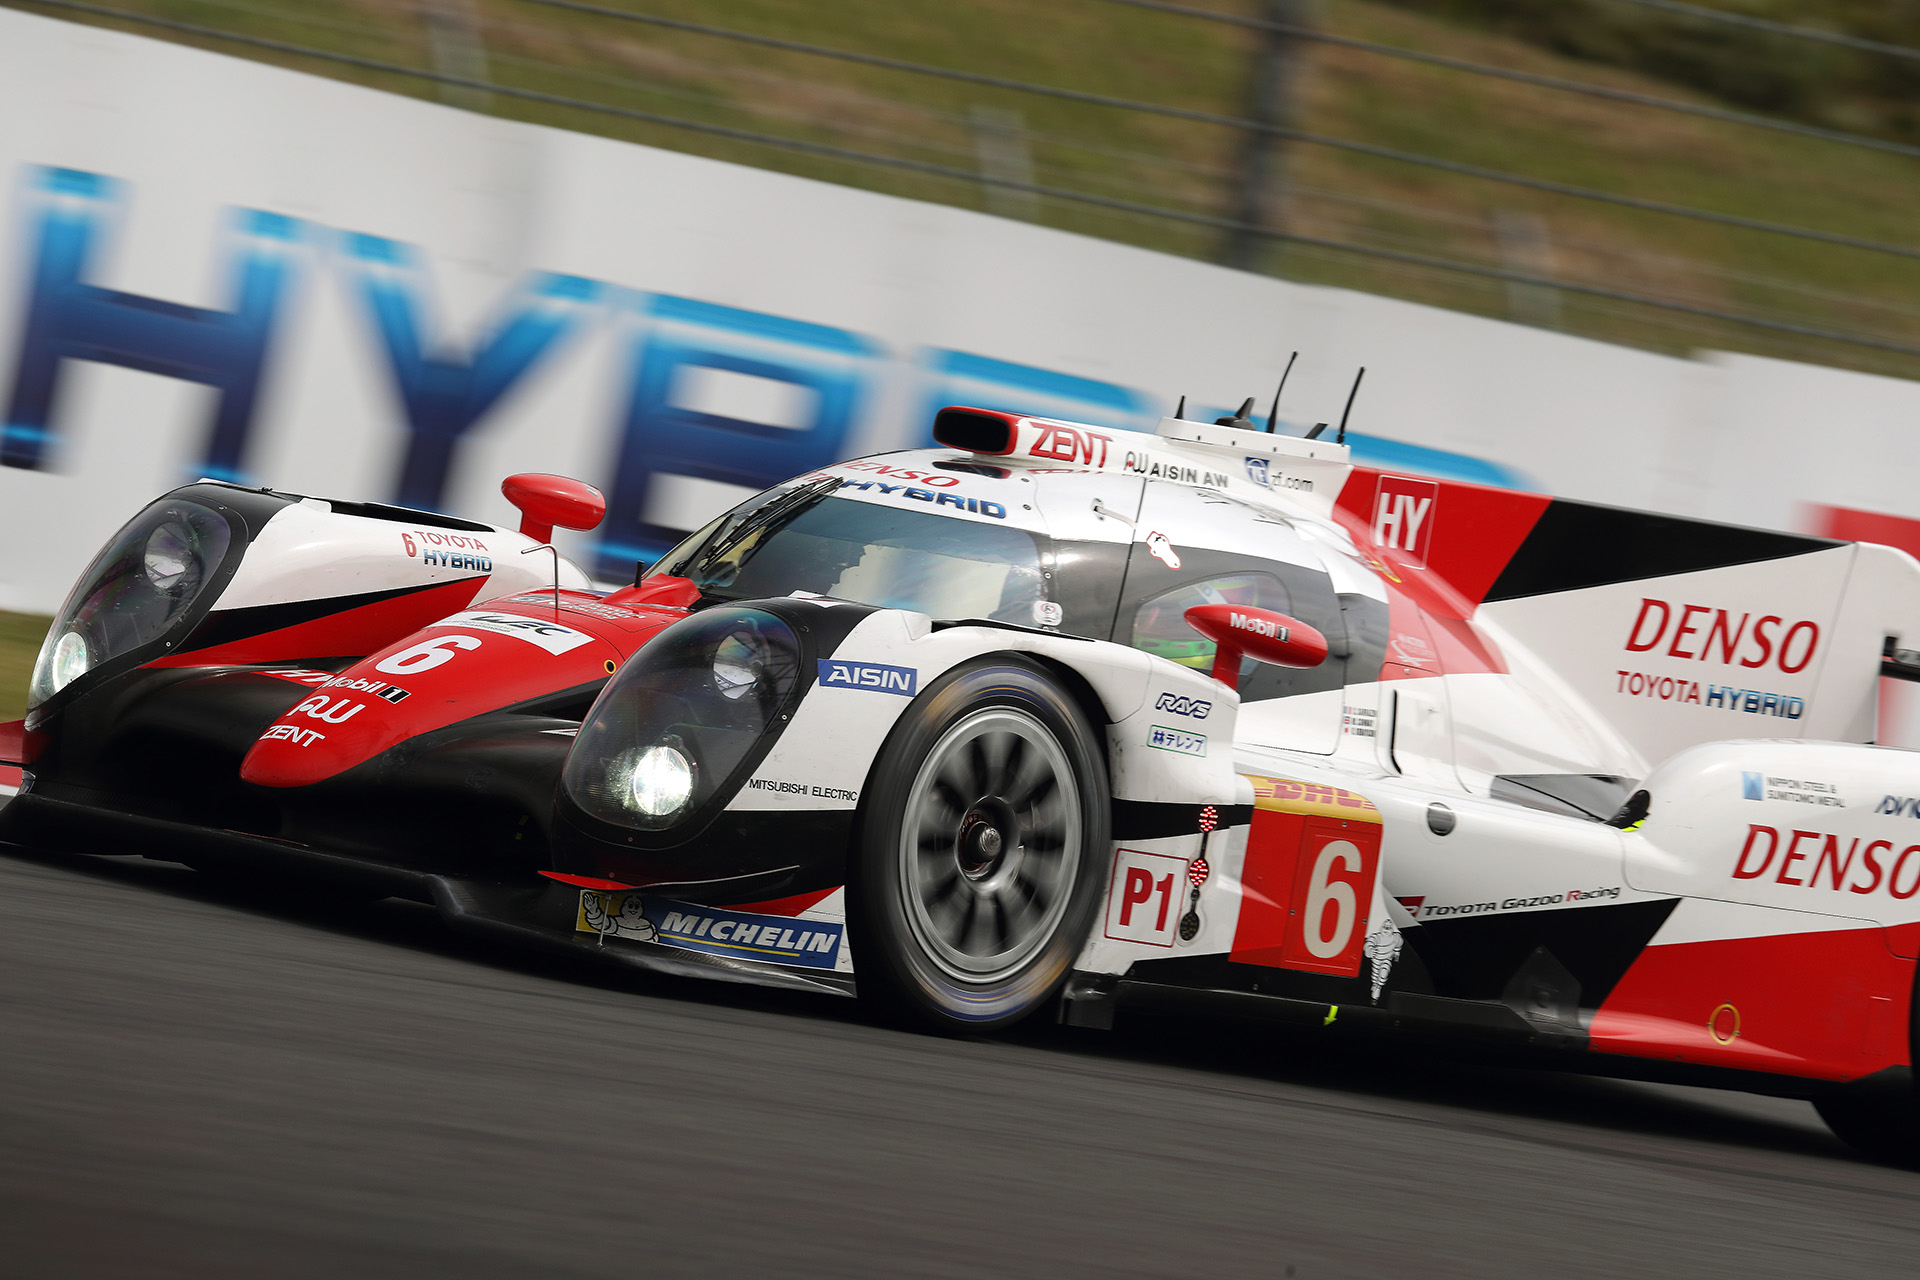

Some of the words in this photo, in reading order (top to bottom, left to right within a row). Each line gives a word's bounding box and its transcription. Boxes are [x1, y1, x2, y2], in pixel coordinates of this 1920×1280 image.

[1028, 421, 1113, 468] ZENT
[1150, 463, 1197, 483] AISIN
[1203, 472, 1228, 488] AW
[1272, 472, 1313, 492] zf.com
[840, 479, 1006, 519] HYBRID
[1374, 492, 1432, 552] HY
[401, 532, 417, 558] 6
[413, 530, 488, 552] TOYOTA
[423, 548, 492, 573] HYBRID
[1230, 611, 1276, 638] Mobil
[1625, 597, 1820, 674] DENSO
[375, 634, 483, 675] 6
[316, 675, 388, 695] Mobil
[826, 665, 911, 691] AISIN
[1155, 692, 1212, 719] RAYS
[1616, 670, 1702, 705] TOYOTA
[1705, 684, 1805, 720] HYBRID
[258, 725, 326, 748] ZENT
[749, 778, 808, 796] MITSUBISHI
[811, 786, 858, 802] ELECTRIC
[1266, 779, 1362, 808] DHL
[1731, 823, 1920, 900] DENSO
[1119, 866, 1175, 932] P1
[1303, 839, 1362, 959] 6
[1423, 902, 1498, 916] TOYOTA
[1501, 894, 1564, 910] GAZOO
[1566, 885, 1621, 903] Racing
[660, 911, 837, 954] MICHELIN
